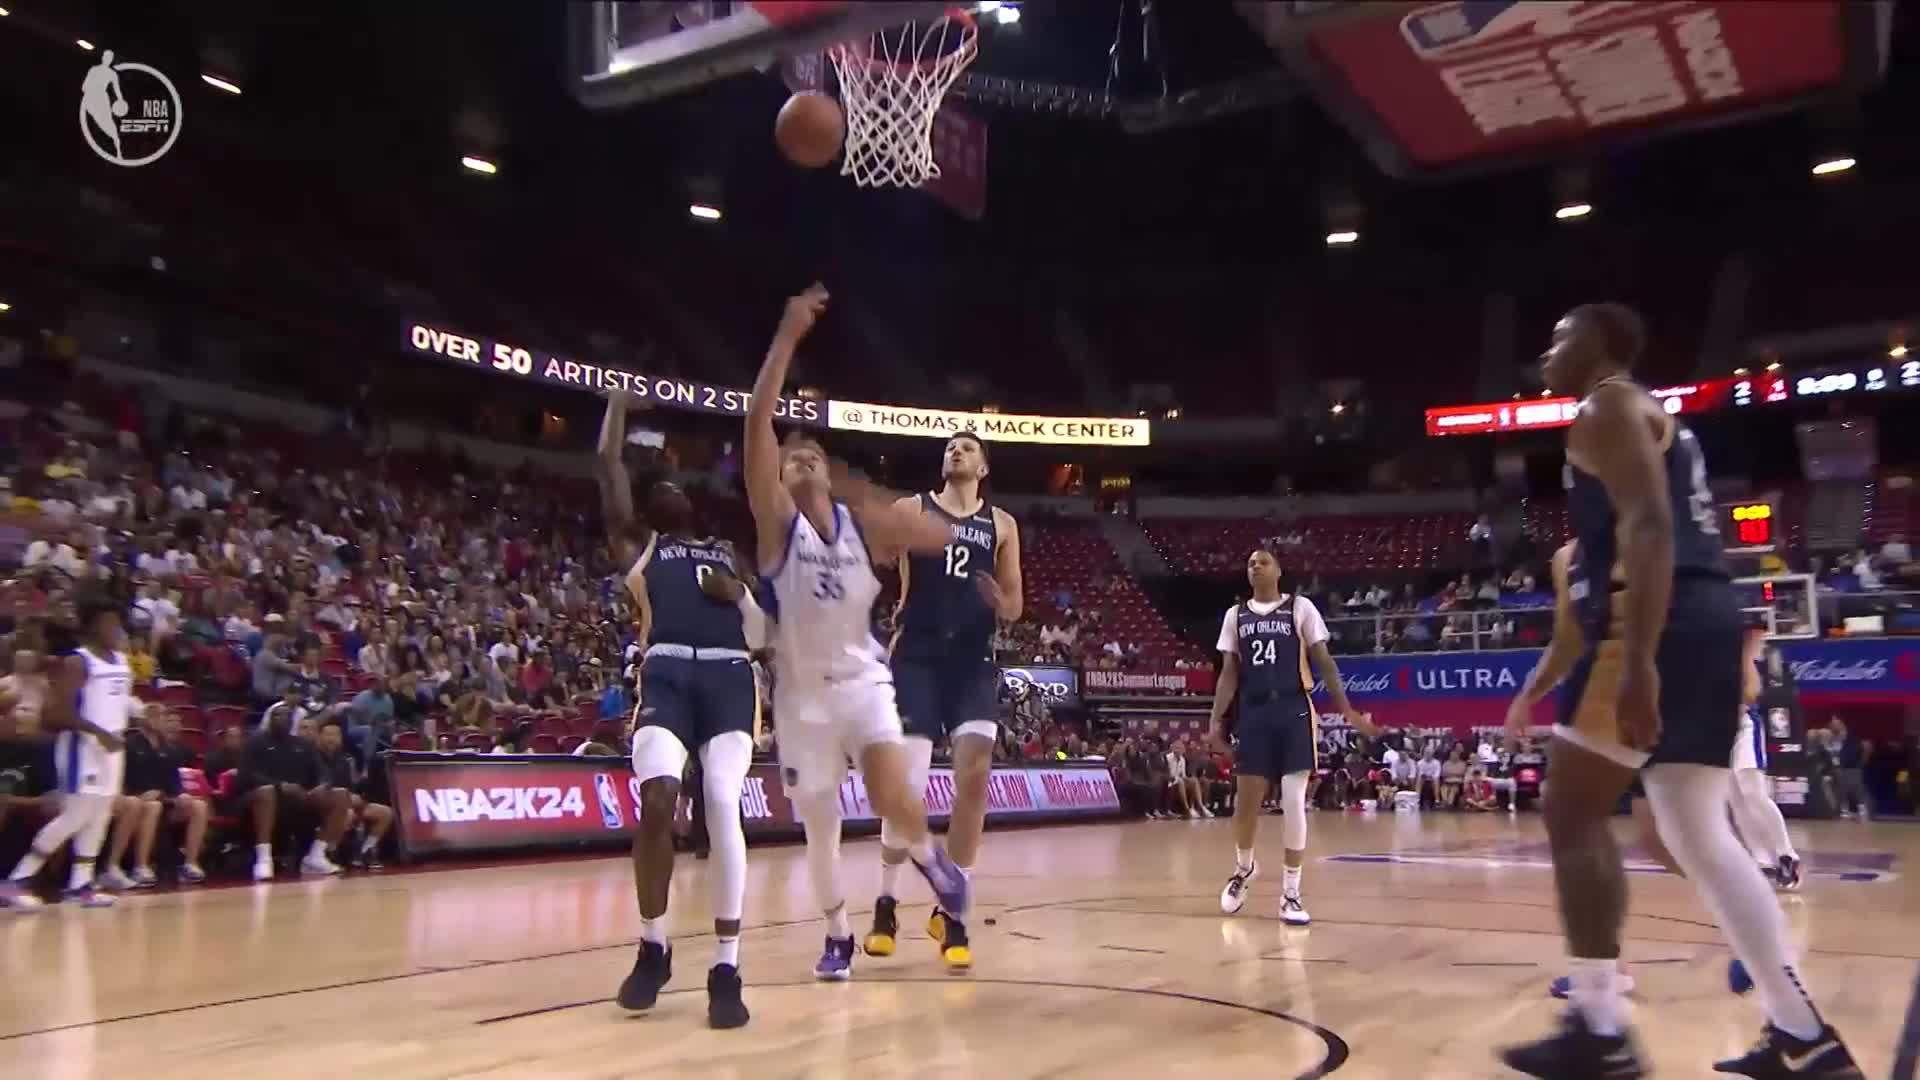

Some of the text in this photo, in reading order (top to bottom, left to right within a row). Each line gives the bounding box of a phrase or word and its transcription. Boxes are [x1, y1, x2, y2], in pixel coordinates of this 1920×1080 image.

[411, 325, 818, 421] OVER 50 ARTISTS ON 2 STGES
[842, 407, 1135, 439] @ THOMAS & MACK CENTER
[659, 545, 688, 561] NEW
[944, 543, 970, 578] 12
[1257, 620, 1291, 636] ORLEANS
[1251, 640, 1277, 666] 24
[1005, 676, 1069, 696] BYD
[1416, 667, 1516, 689] ULTRA
[414, 786, 586, 823] NBA2K24
